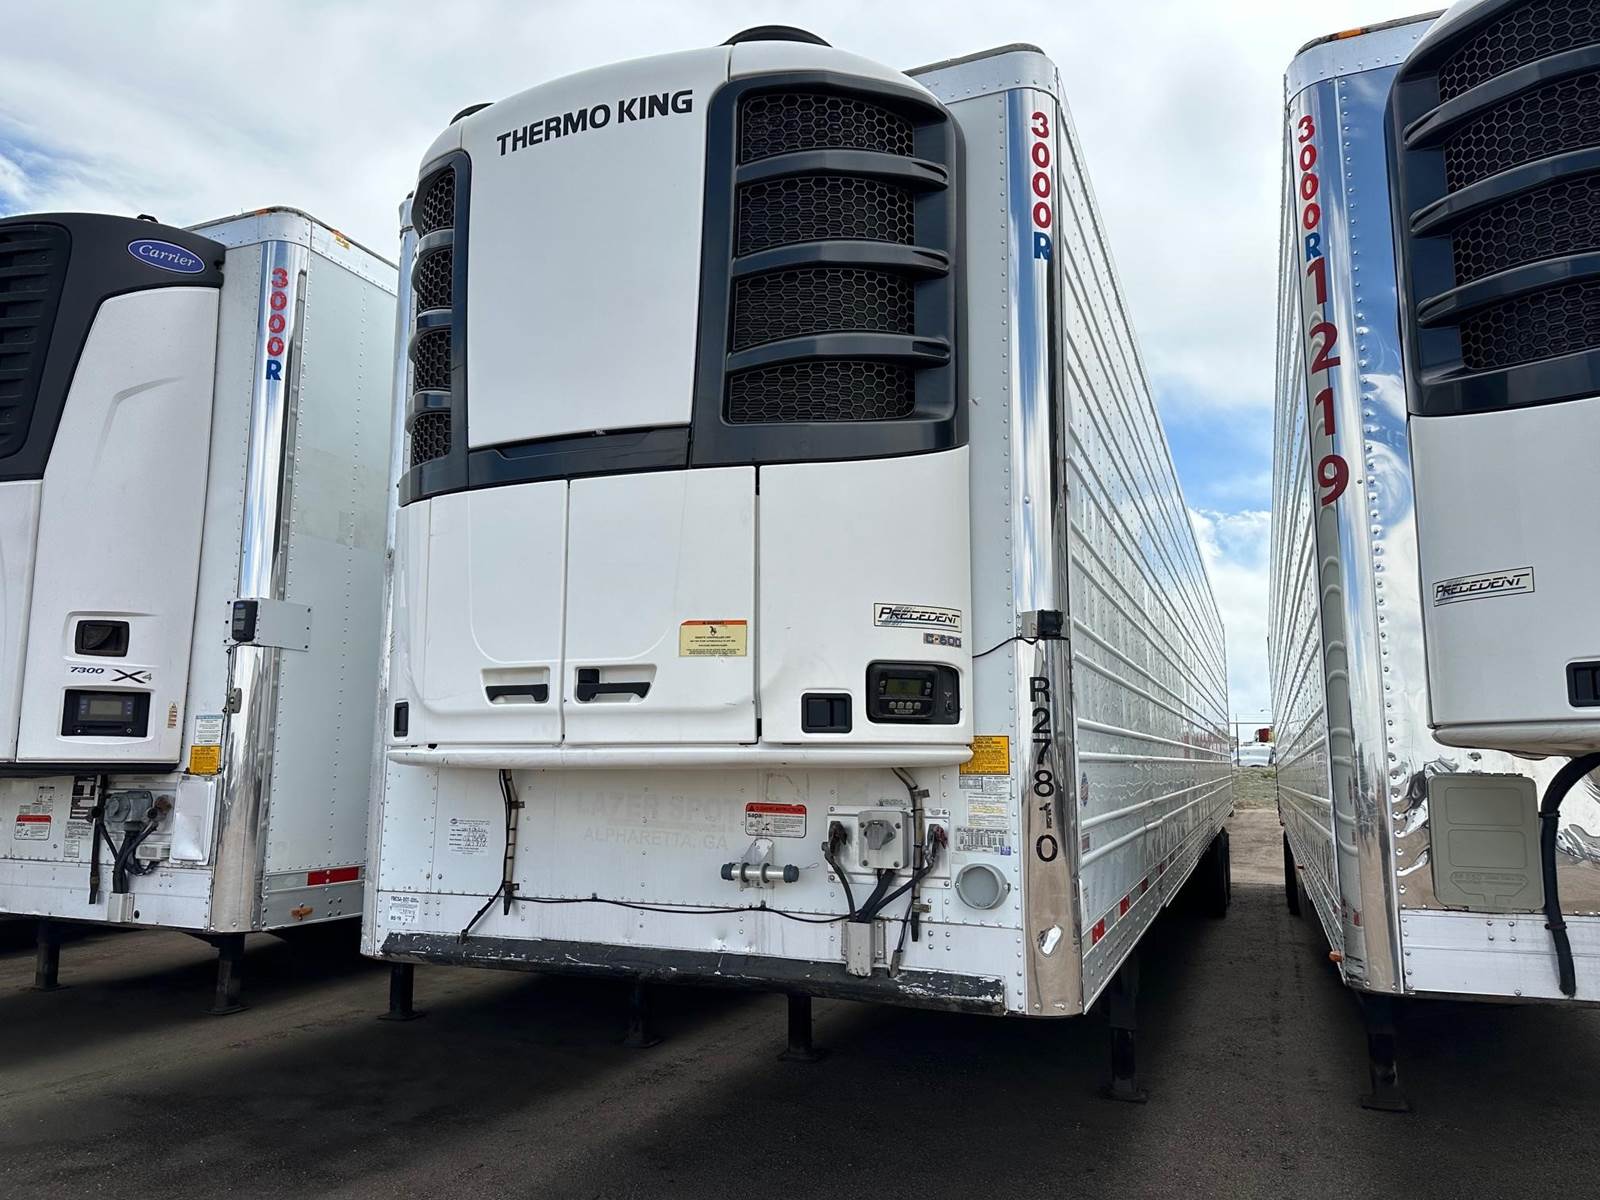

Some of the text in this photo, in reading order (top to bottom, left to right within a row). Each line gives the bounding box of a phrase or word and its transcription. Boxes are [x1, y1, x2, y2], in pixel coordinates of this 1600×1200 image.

[497, 89, 693, 157] THERMO KING
[1031, 111, 1052, 261] 3000R
[1297, 114, 1323, 262] 3000R
[139, 244, 196, 267] Carrier
[265, 267, 290, 381] 3000R
[1306, 256, 1350, 507] 1219
[1435, 572, 1531, 599] PRECEDENT
[879, 606, 961, 624] PRECEDENT
[70, 666, 105, 674] 7300
[703, 834, 729, 851] GA
